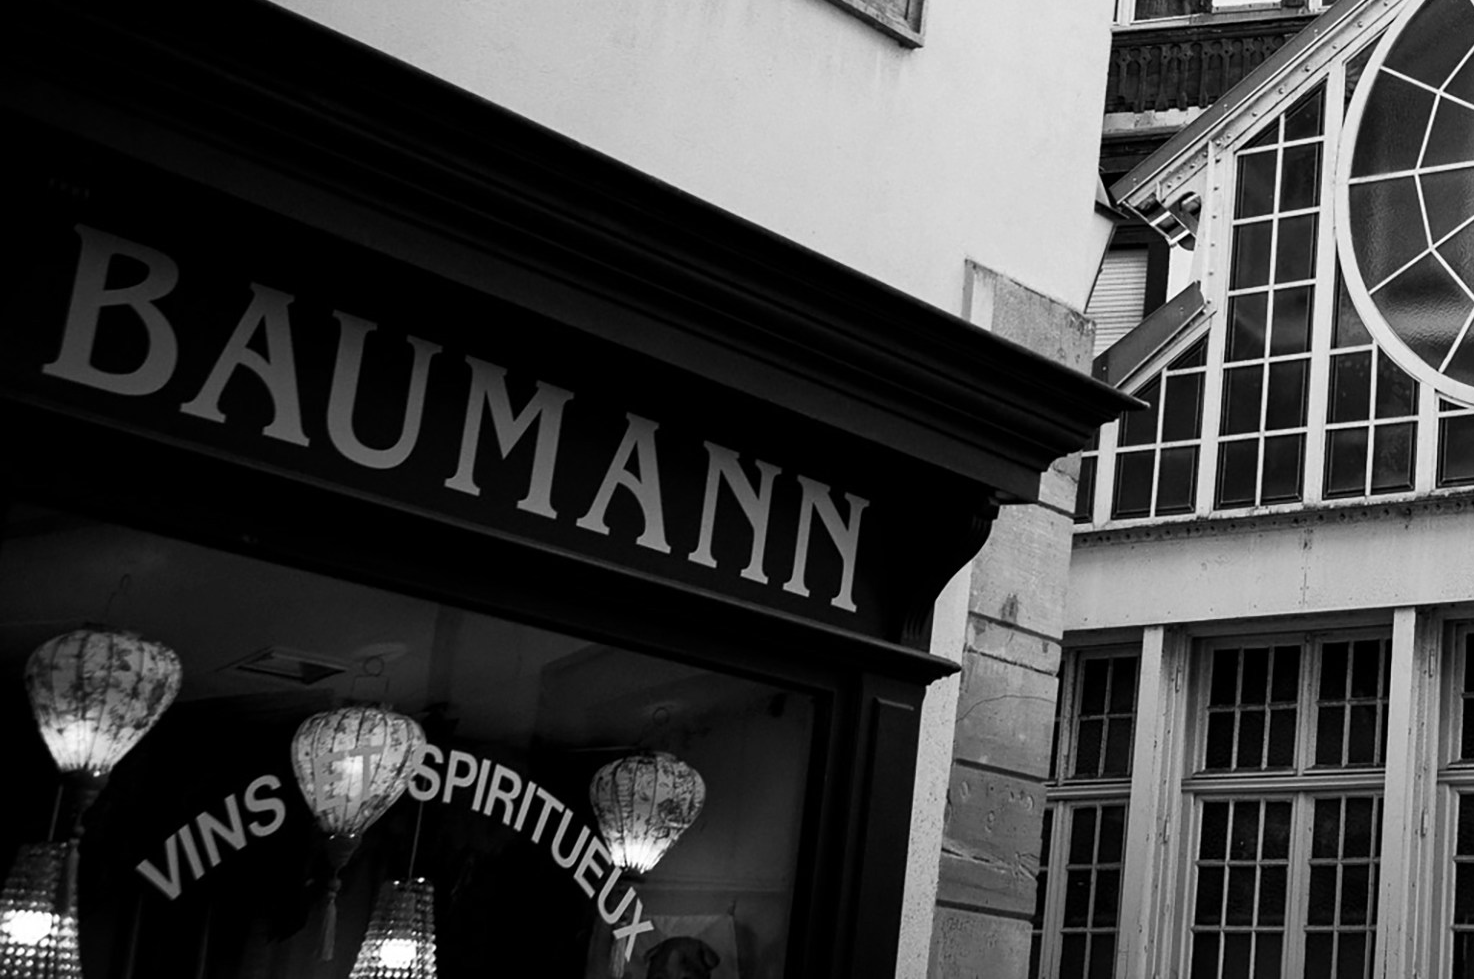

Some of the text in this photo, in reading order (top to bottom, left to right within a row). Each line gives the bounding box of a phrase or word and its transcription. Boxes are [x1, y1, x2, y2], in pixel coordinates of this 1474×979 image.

[42, 223, 870, 614] BAUMANN
[136, 743, 655, 963] VINS ET SPIRITUEUX
